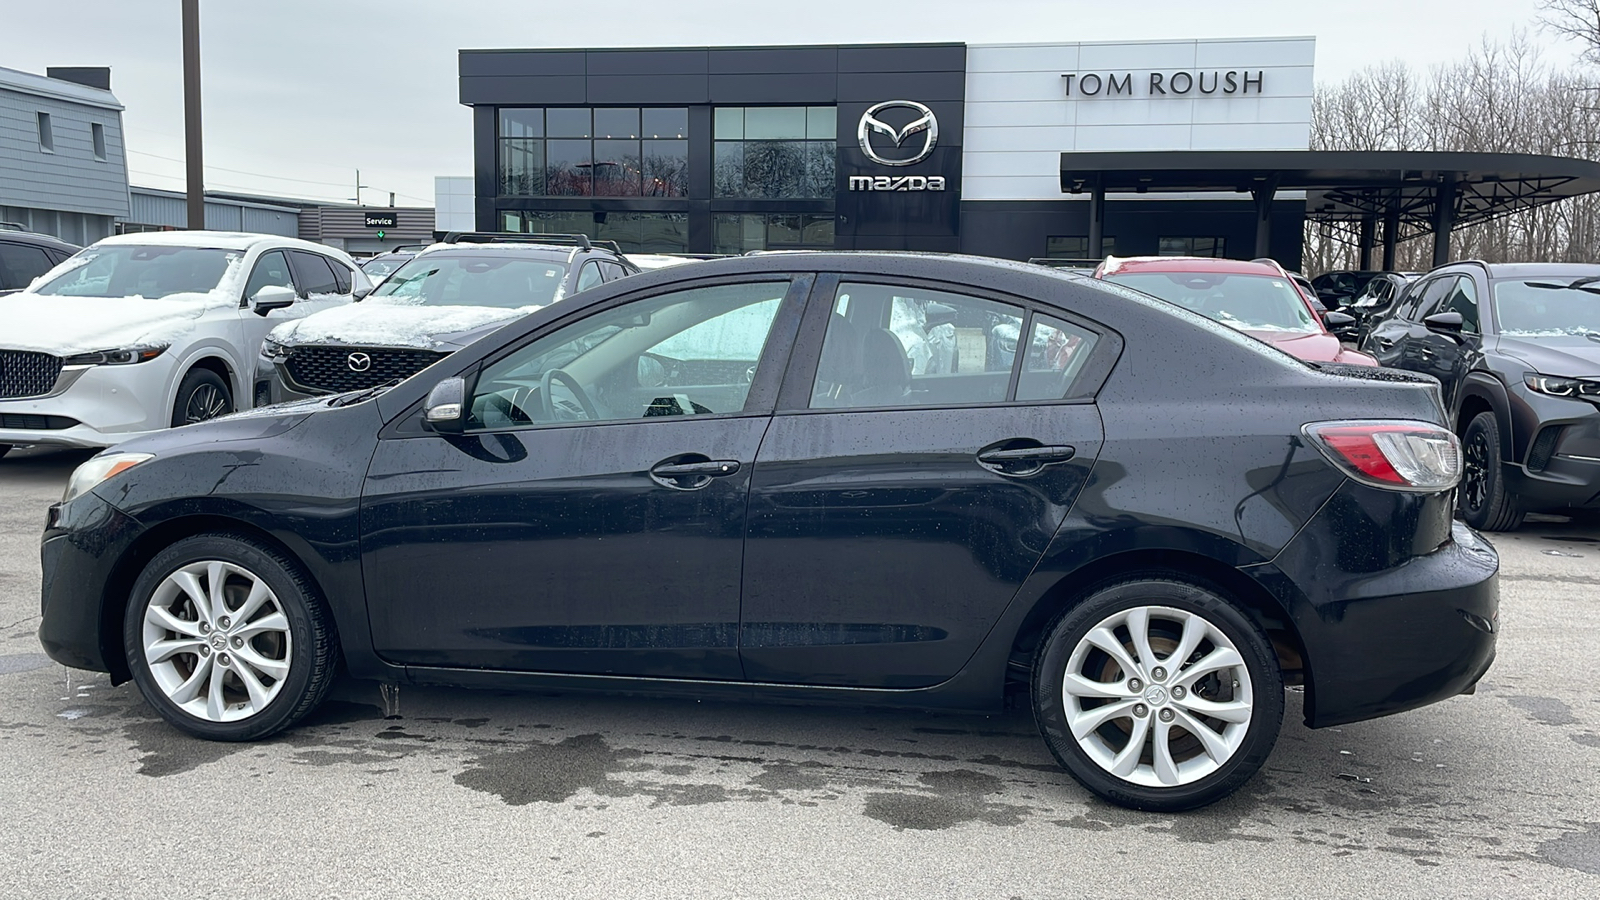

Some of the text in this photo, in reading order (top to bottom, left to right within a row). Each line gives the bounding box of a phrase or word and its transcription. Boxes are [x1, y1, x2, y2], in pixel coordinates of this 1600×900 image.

[1061, 71, 1263, 96] TOM ROUSH
[849, 176, 946, 191] mazda
[366, 217, 393, 225] Service
